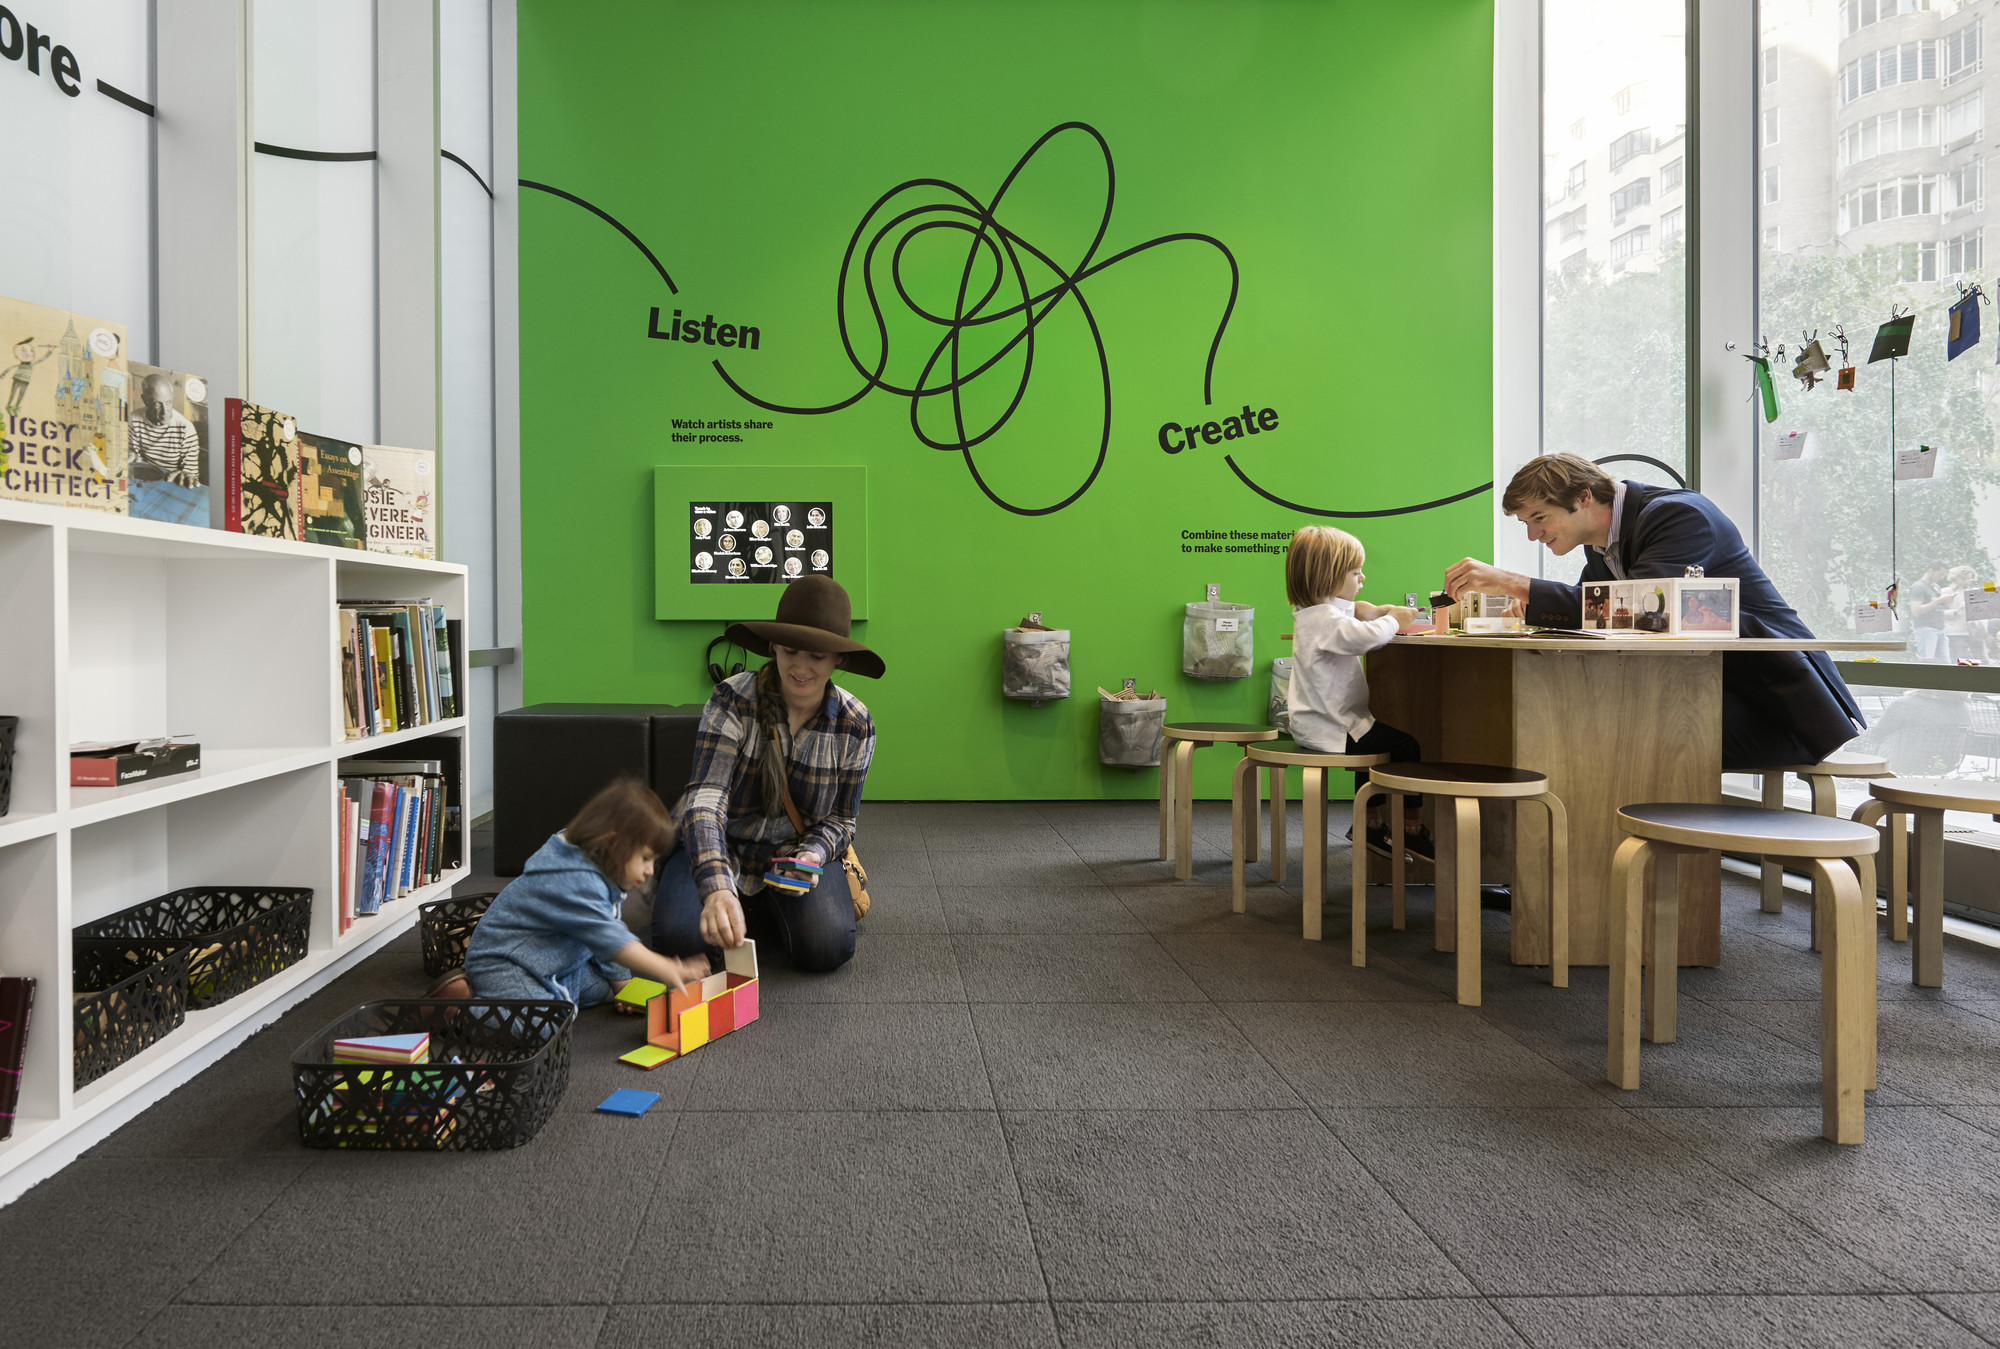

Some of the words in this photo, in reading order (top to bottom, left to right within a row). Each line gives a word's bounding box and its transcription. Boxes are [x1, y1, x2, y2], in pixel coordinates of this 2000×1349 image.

[647, 307, 761, 350] Listen
[10, 415, 75, 442] IGGY
[671, 419, 704, 429] Watch
[707, 419, 741, 429] artists
[744, 419, 773, 429] share
[1158, 405, 1279, 455] Create
[671, 433, 696, 442] their
[699, 433, 743, 445] process.
[320, 449, 339, 463] Essays
[327, 465, 360, 480] Assemblage
[1181, 530, 1227, 540] Combine
[1230, 530, 1259, 540] these
[1261, 530, 1295, 540] materi
[1181, 543, 1192, 553] to
[1194, 543, 1223, 553] make
[1225, 543, 1281, 555] something
[121, 769, 148, 780] FaceMaker
